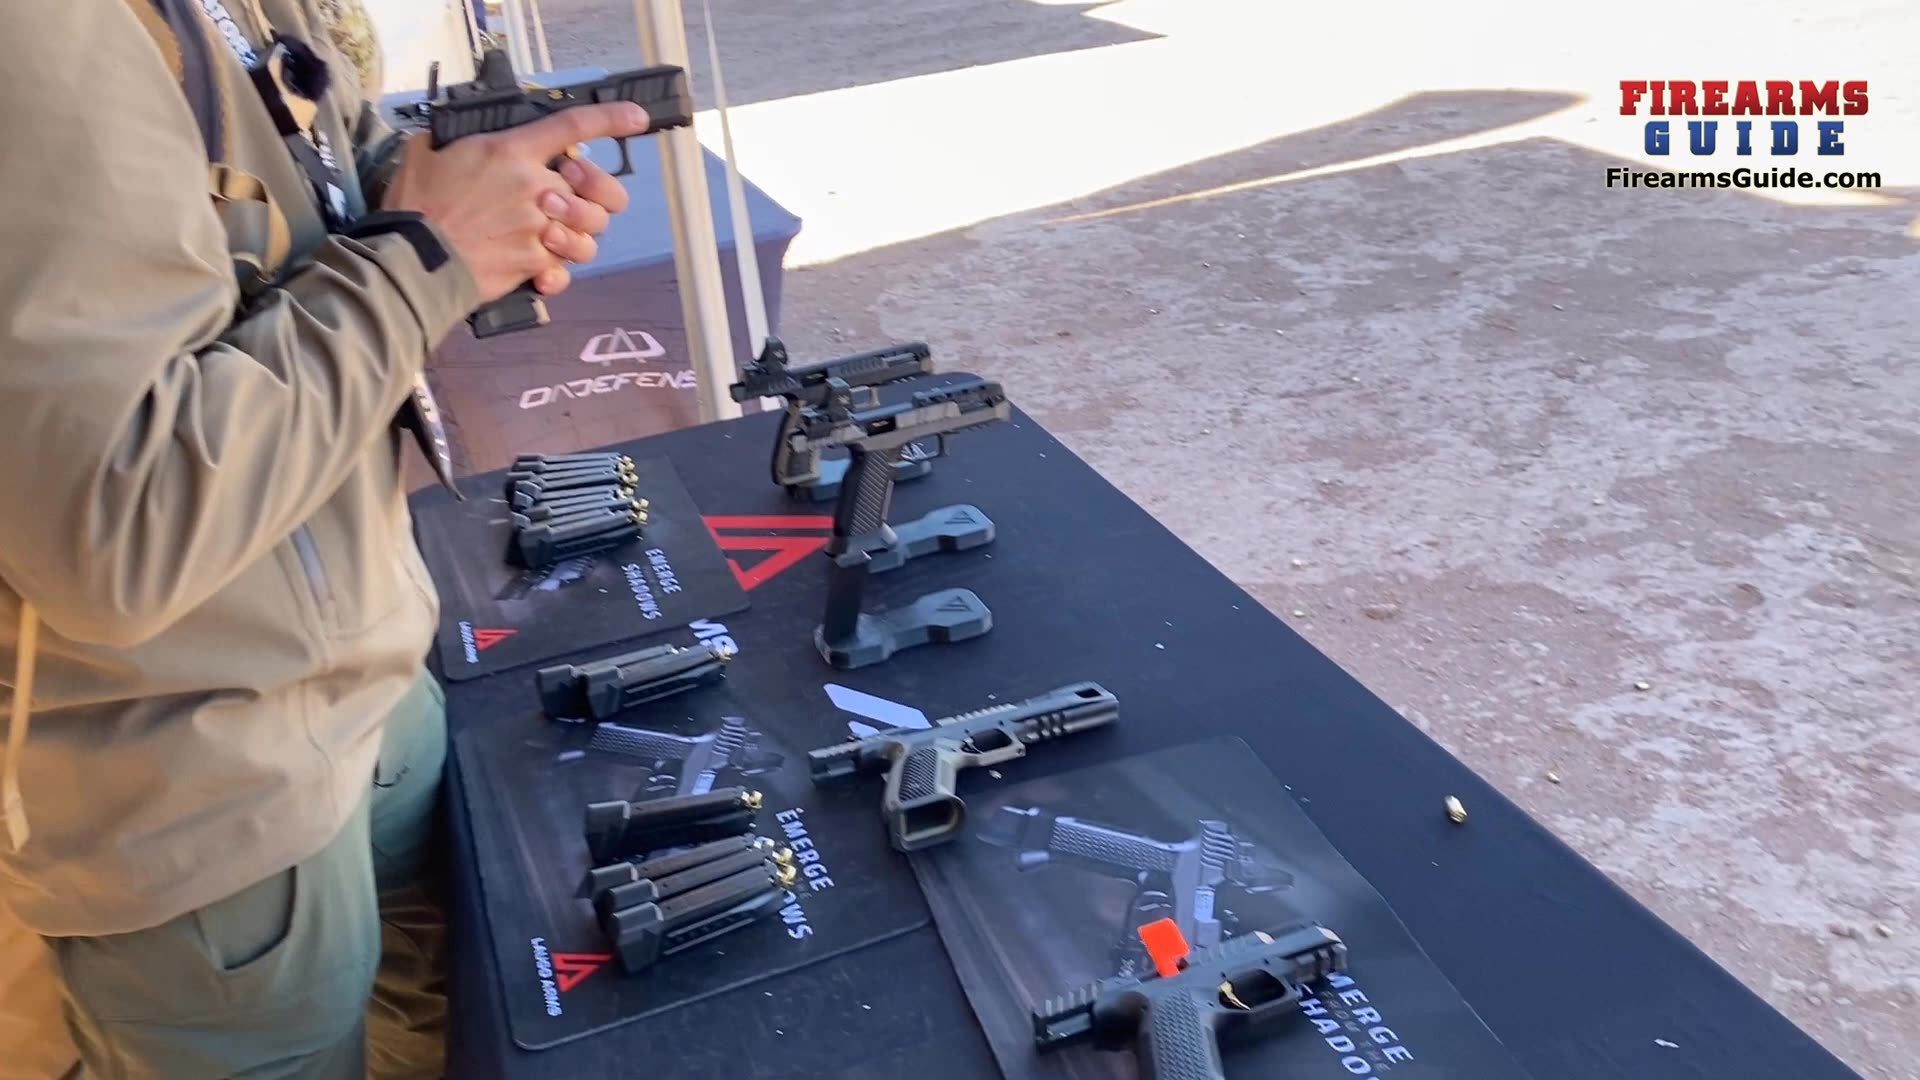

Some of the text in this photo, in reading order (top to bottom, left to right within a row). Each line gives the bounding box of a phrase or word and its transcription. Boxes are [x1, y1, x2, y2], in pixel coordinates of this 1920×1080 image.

[621, 563, 663, 620] SHADOWS
[645, 548, 682, 594] EMERGE
[775, 809, 835, 892] EMERGE
[1298, 984, 1380, 1080] HADO
[1326, 973, 1414, 1063] MERGE
